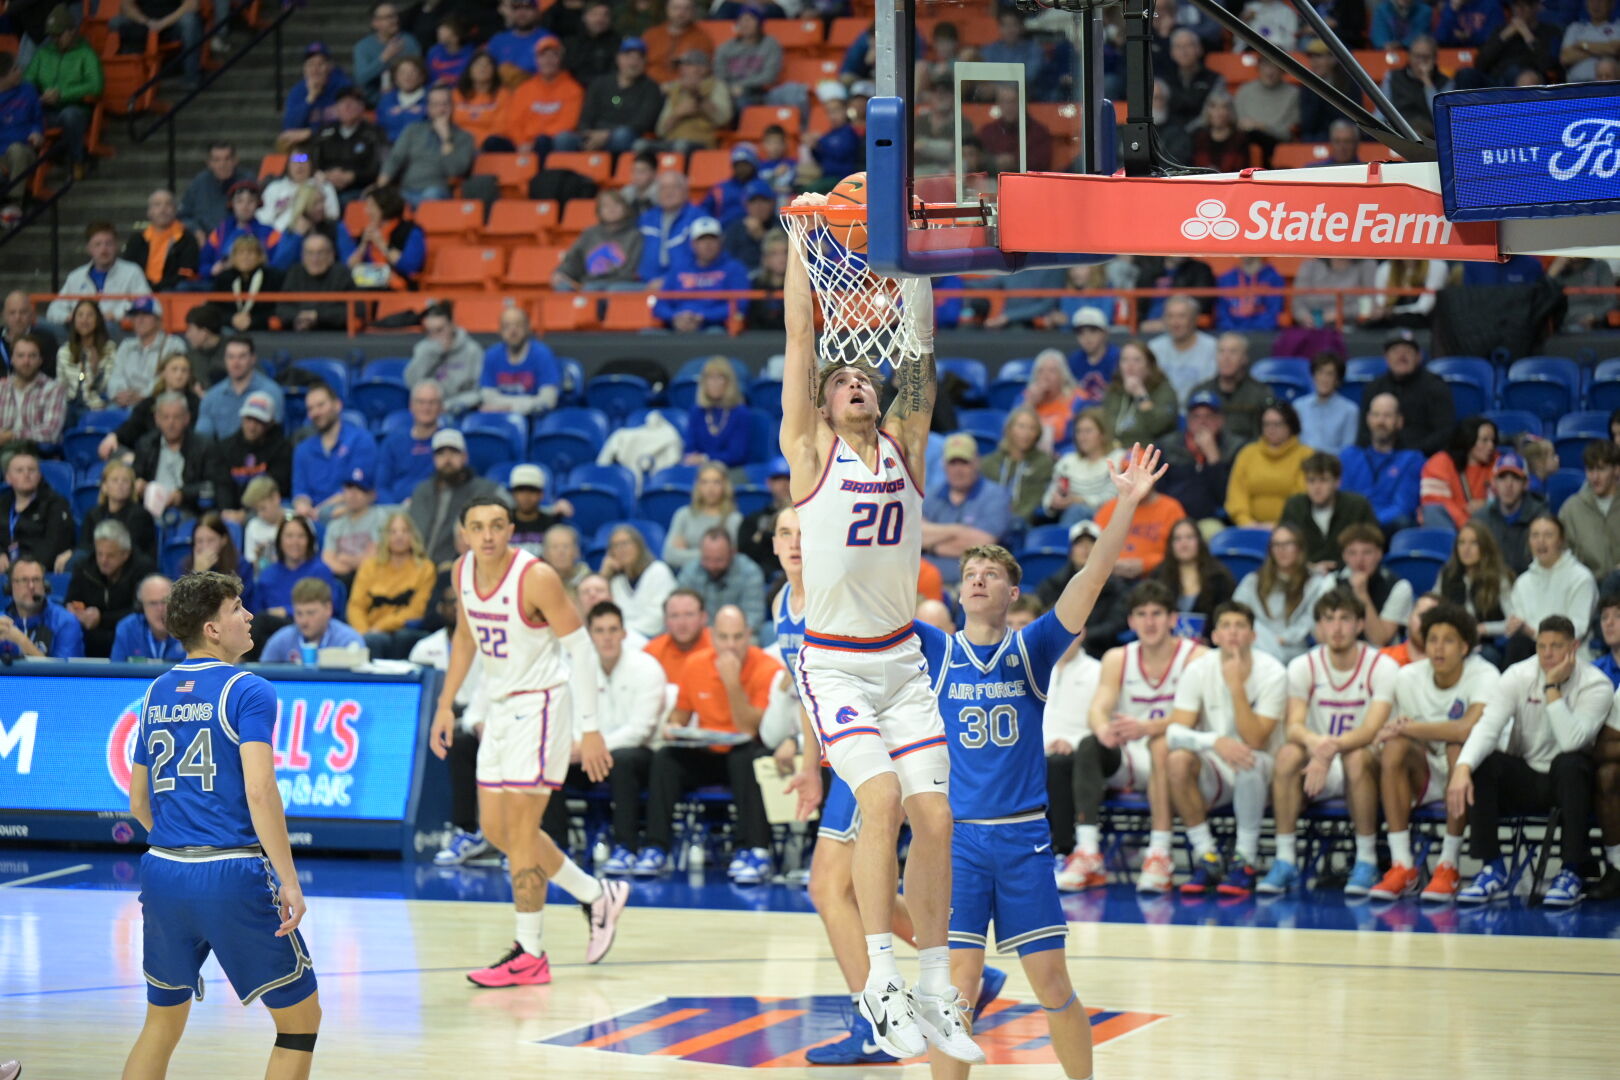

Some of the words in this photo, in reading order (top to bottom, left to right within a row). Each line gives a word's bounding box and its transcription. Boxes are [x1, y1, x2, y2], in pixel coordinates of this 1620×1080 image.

[1481, 147, 1540, 165] BUILT
[846, 501, 904, 547] 20
[476, 625, 508, 659] 22
[948, 682, 974, 700] AIR
[975, 680, 1026, 700] FORCE
[147, 703, 214, 725] FALCONS
[958, 704, 1019, 749] 30
[147, 728, 217, 794] 24
